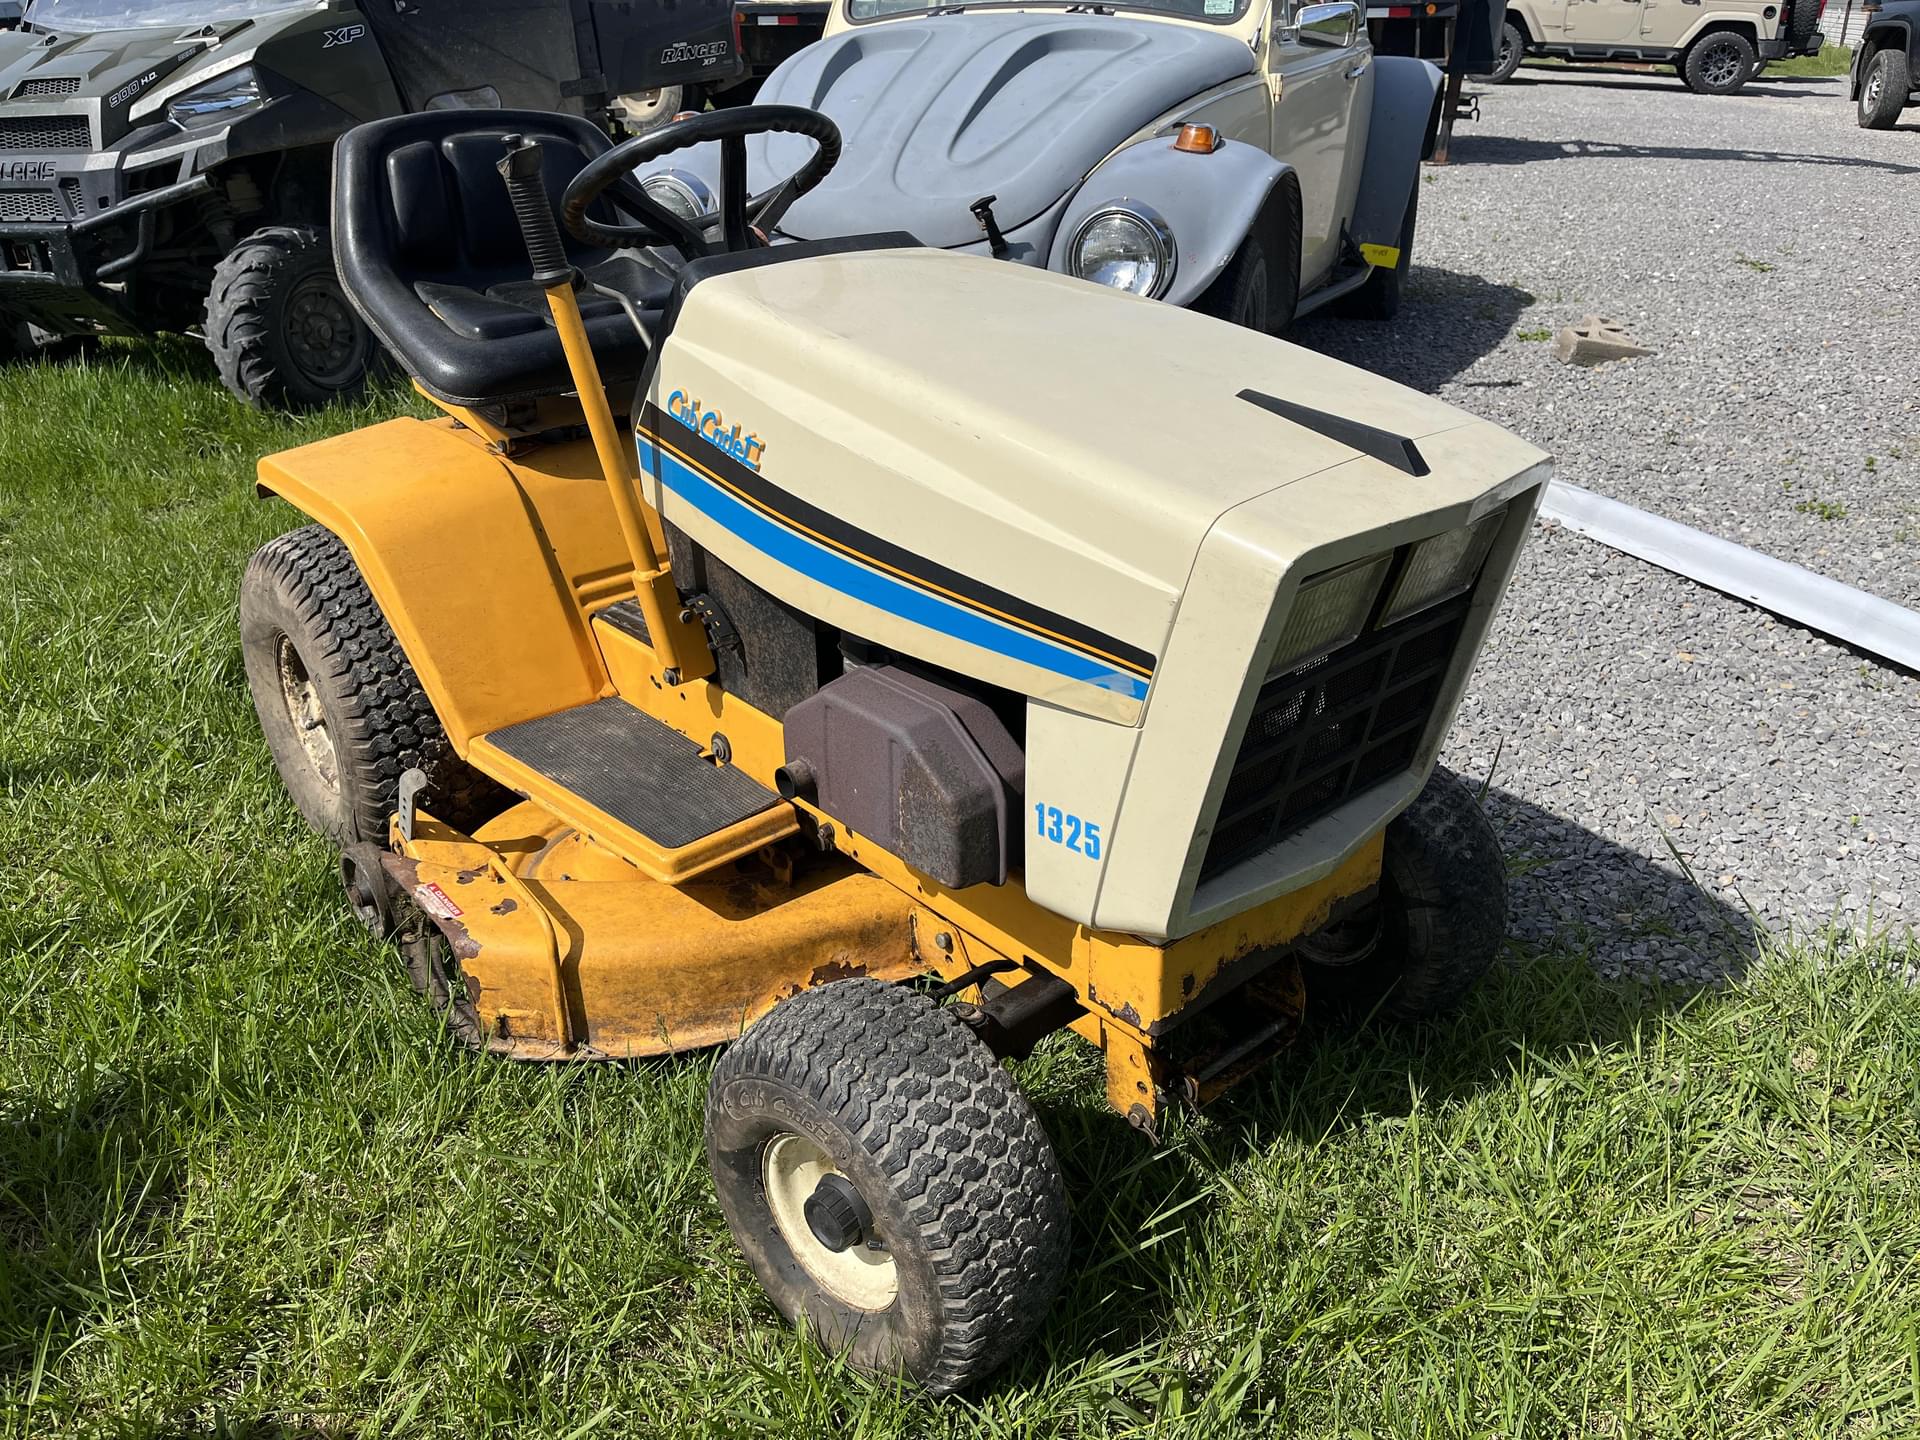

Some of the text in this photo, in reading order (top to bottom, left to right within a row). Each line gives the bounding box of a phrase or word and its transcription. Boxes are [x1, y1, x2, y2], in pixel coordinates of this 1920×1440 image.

[322, 24, 365, 48] XP
[660, 40, 728, 64] RANGER
[702, 57, 717, 66] XP
[109, 80, 140, 108] 900
[667, 387, 766, 473] Cub Cadet
[1035, 802, 1100, 861] 1325
[434, 889, 462, 916] DANGER
